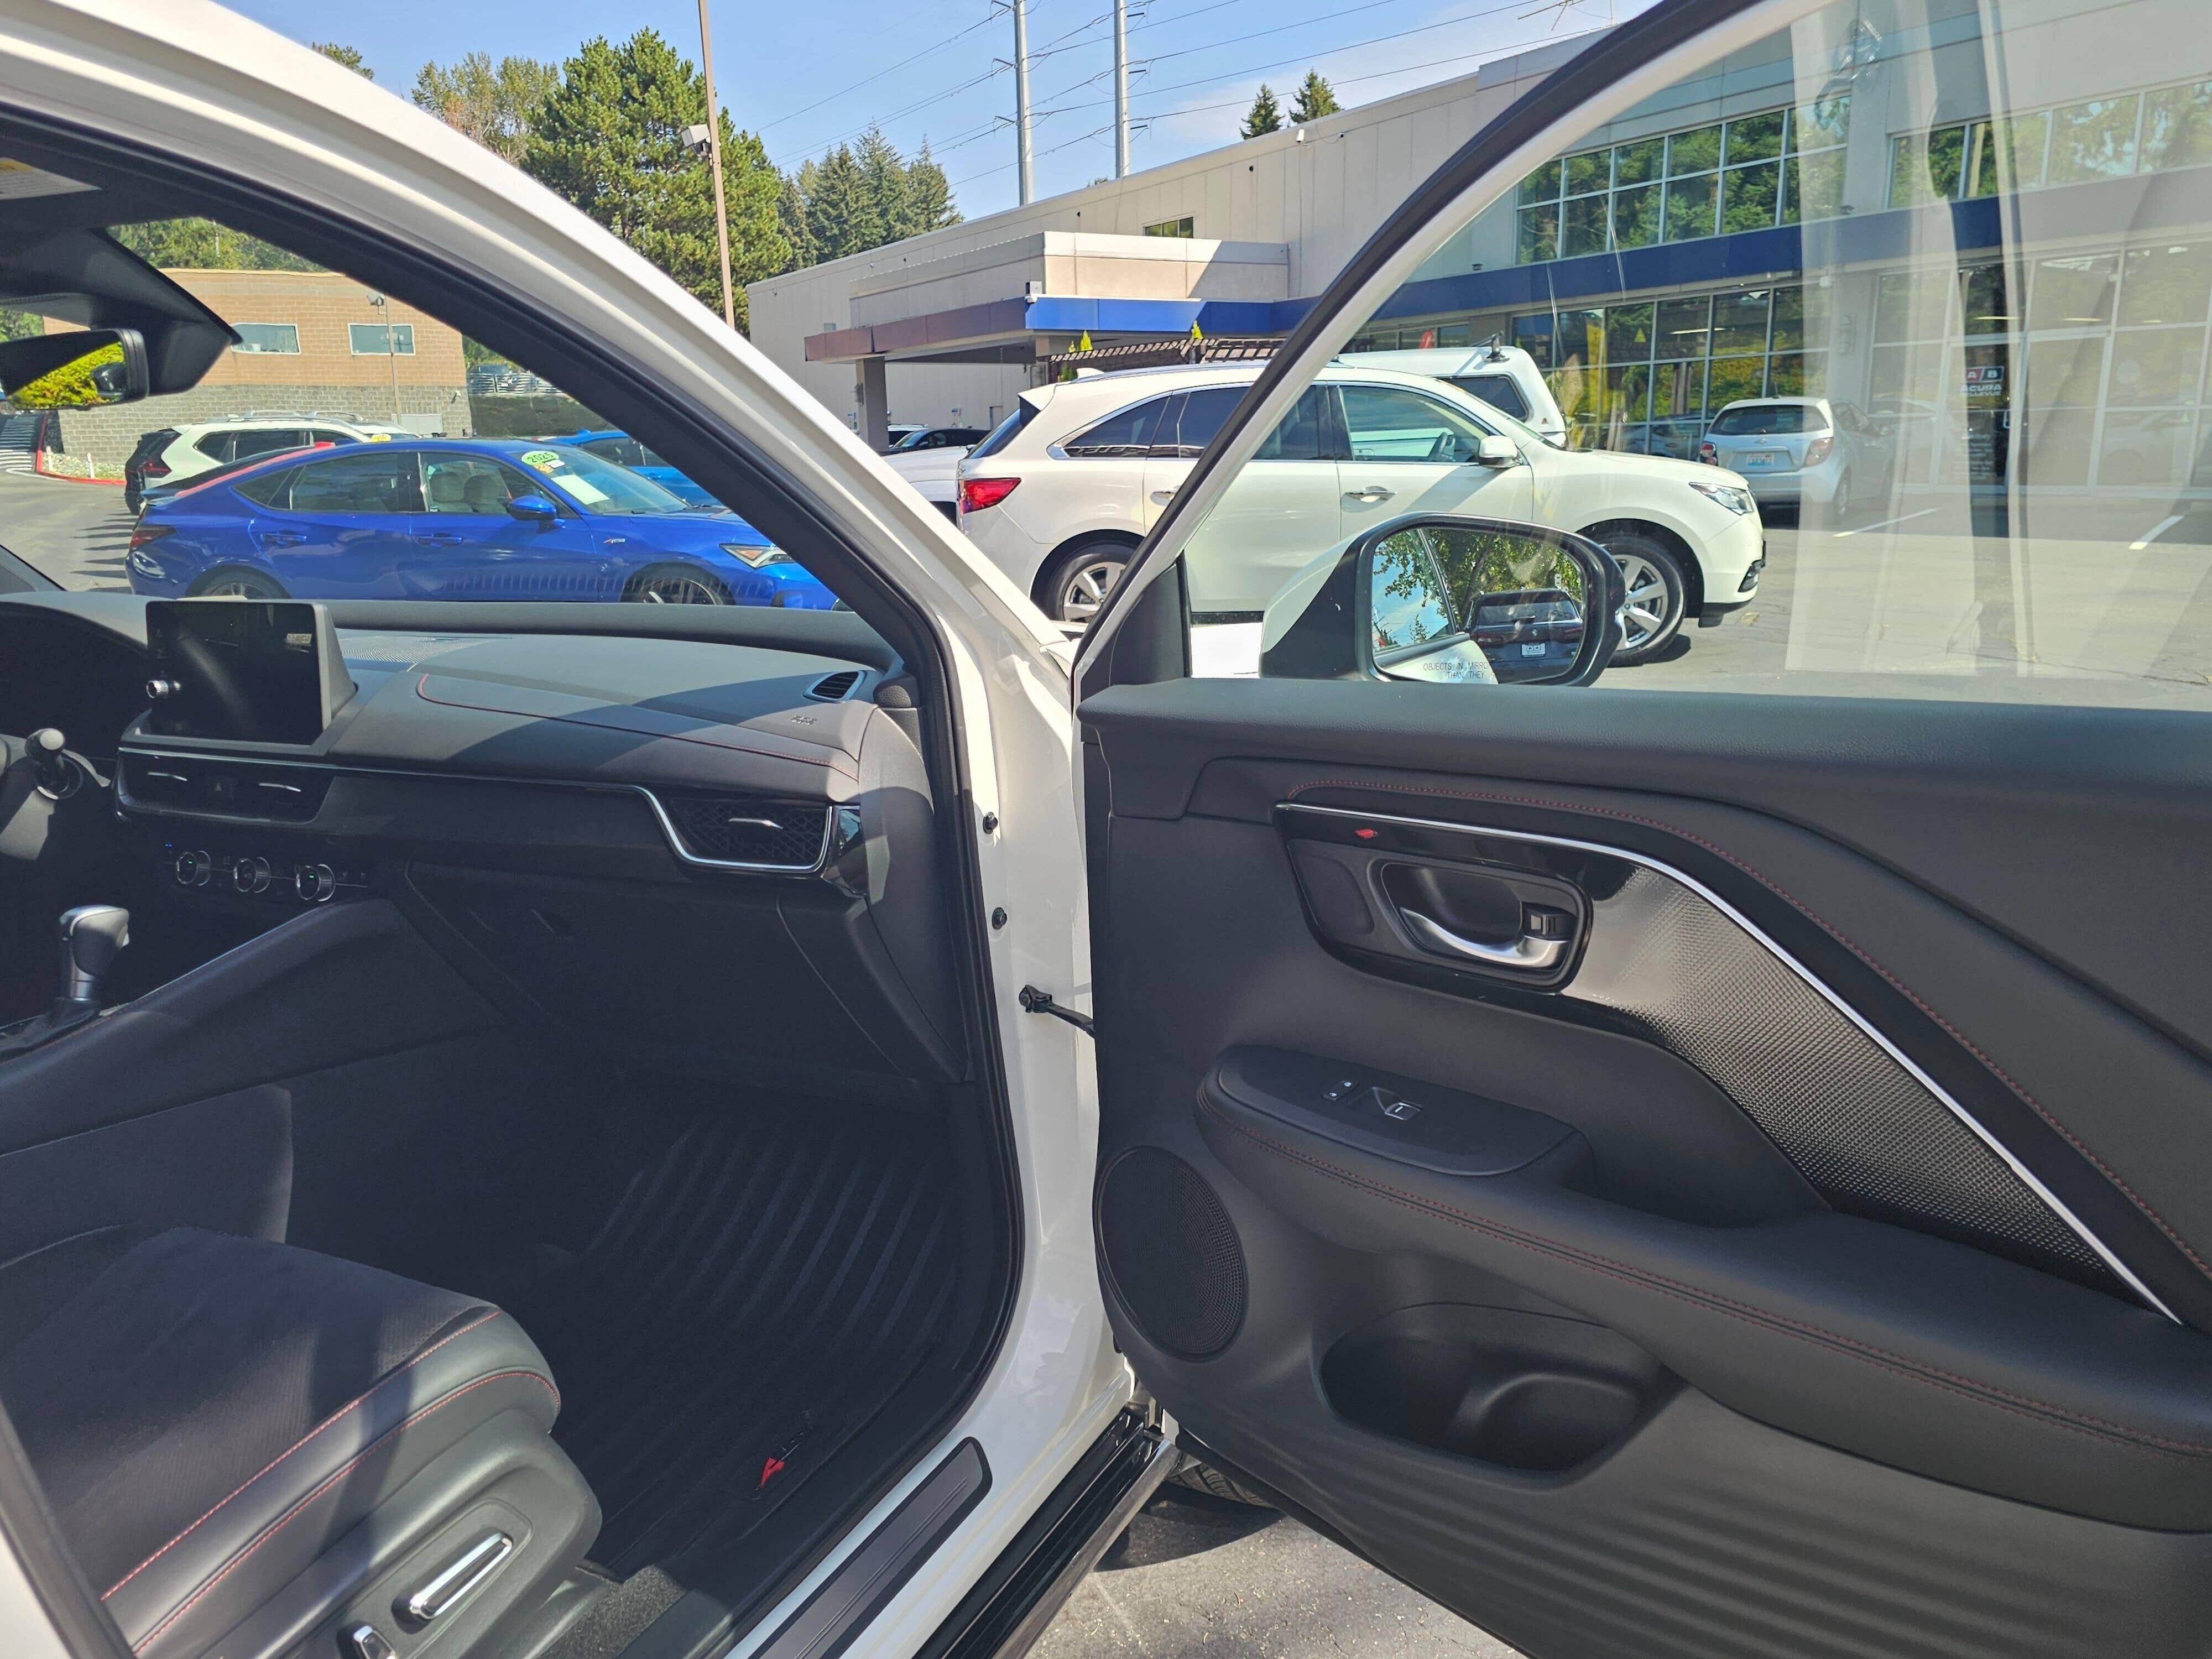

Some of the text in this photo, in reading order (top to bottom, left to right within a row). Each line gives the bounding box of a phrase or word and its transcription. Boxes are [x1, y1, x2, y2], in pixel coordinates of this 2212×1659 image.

[527, 452, 554, 463] 2025
[1423, 662, 1452, 671] OBJECTS
[1468, 661, 1488, 670] MIRRO
[1448, 671, 1464, 680] THAN
[1469, 671, 1484, 679] THEY
